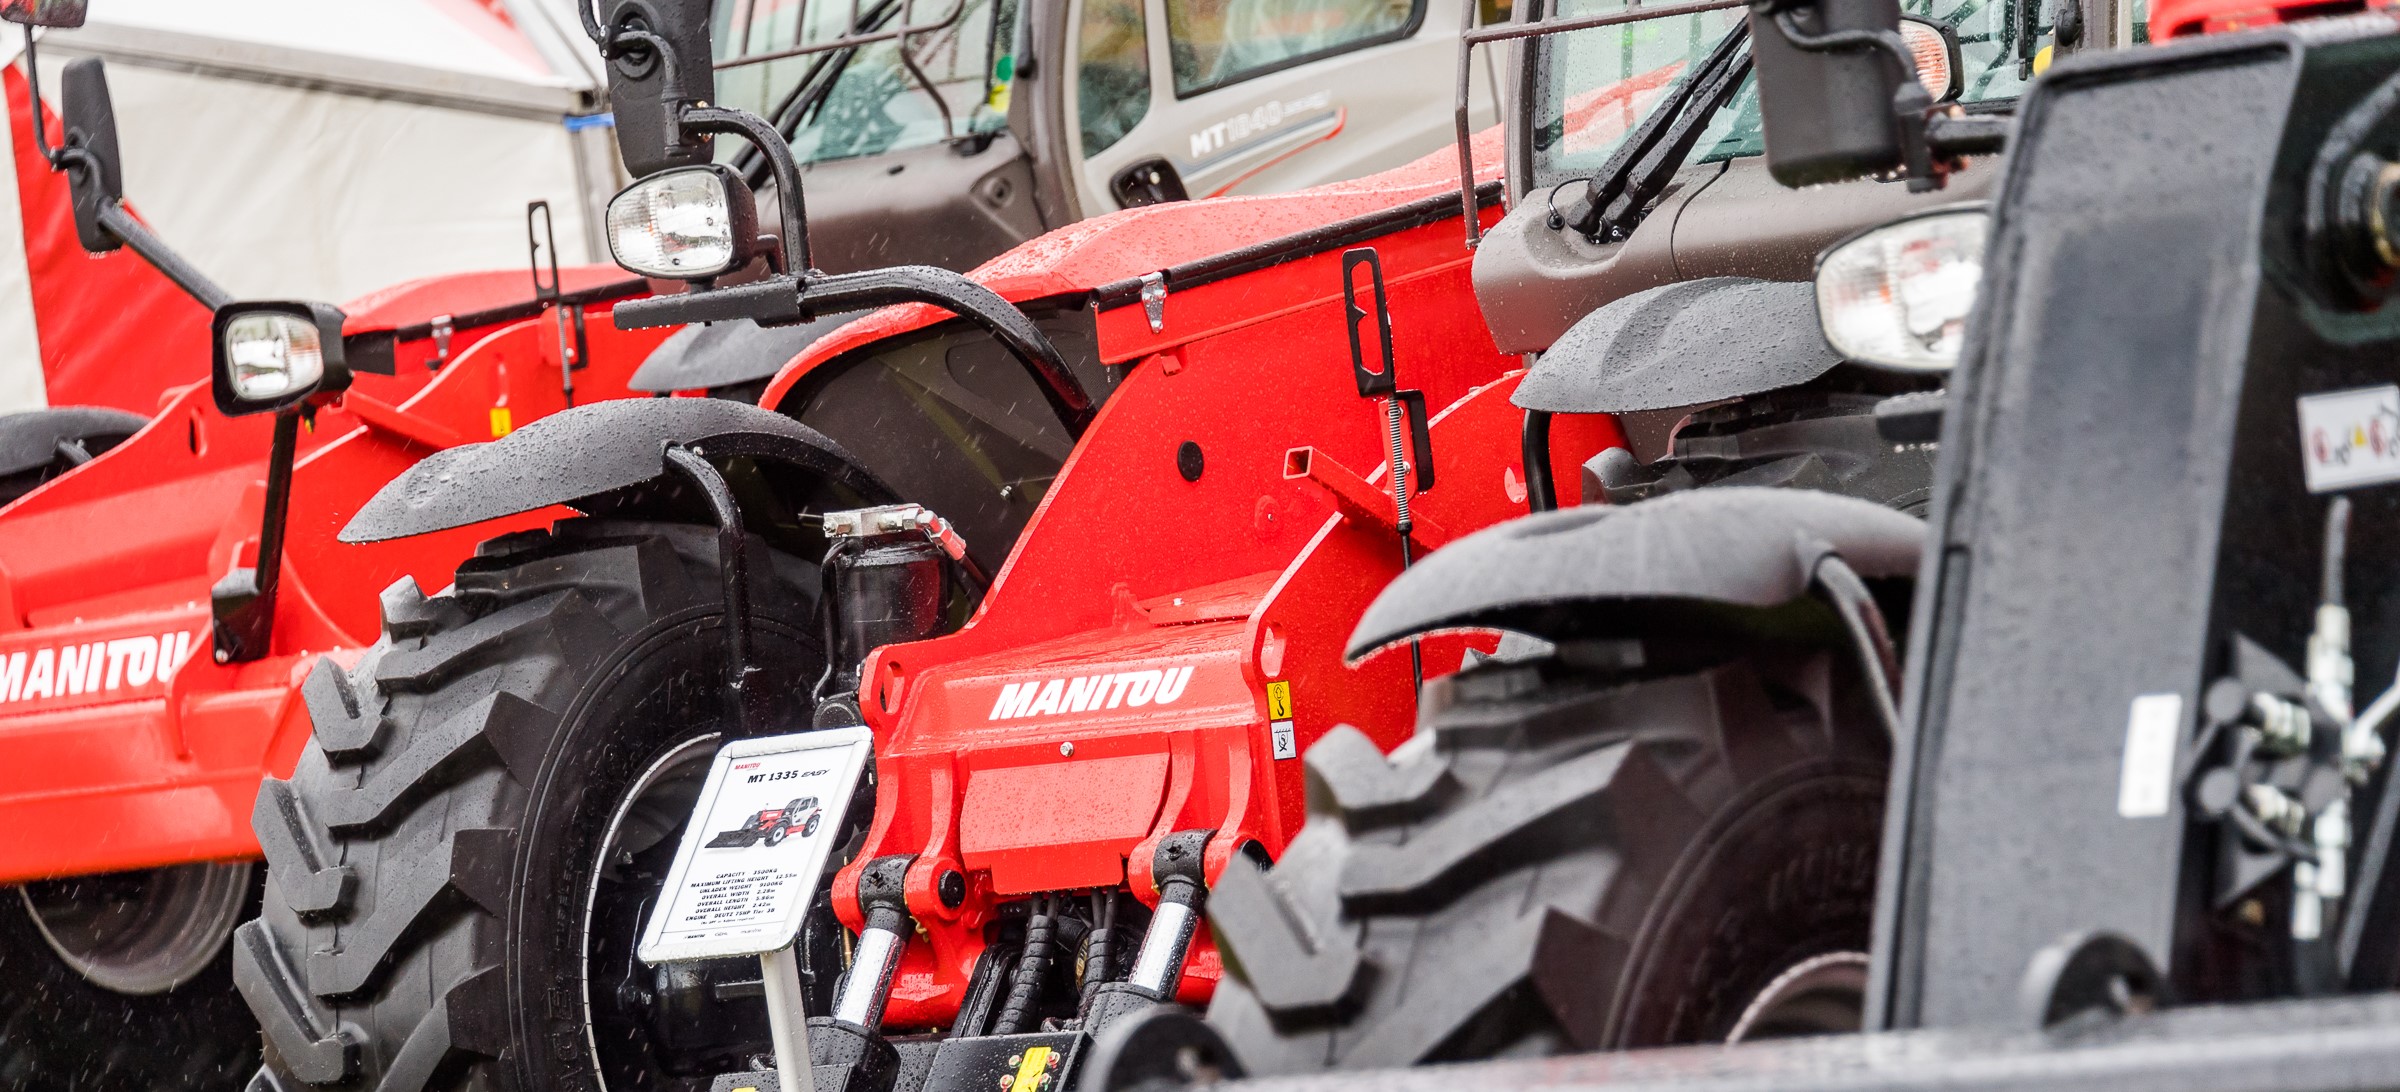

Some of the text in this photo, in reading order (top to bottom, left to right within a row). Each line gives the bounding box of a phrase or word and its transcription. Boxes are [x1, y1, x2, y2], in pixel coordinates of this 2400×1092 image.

[0, 631, 190, 704] MANITOU
[988, 666, 1195, 721] MANITOU
[734, 762, 761, 770] MANITOU
[747, 768, 831, 784] MT 1335 EASY
[716, 871, 745, 879] CAPACITY
[690, 880, 720, 888] MAXIMUM
[699, 886, 727, 894] UNLADEN
[729, 883, 752, 891] WEIGHT
[730, 890, 750, 898] WIDTH
[695, 906, 721, 914] OVERALL
